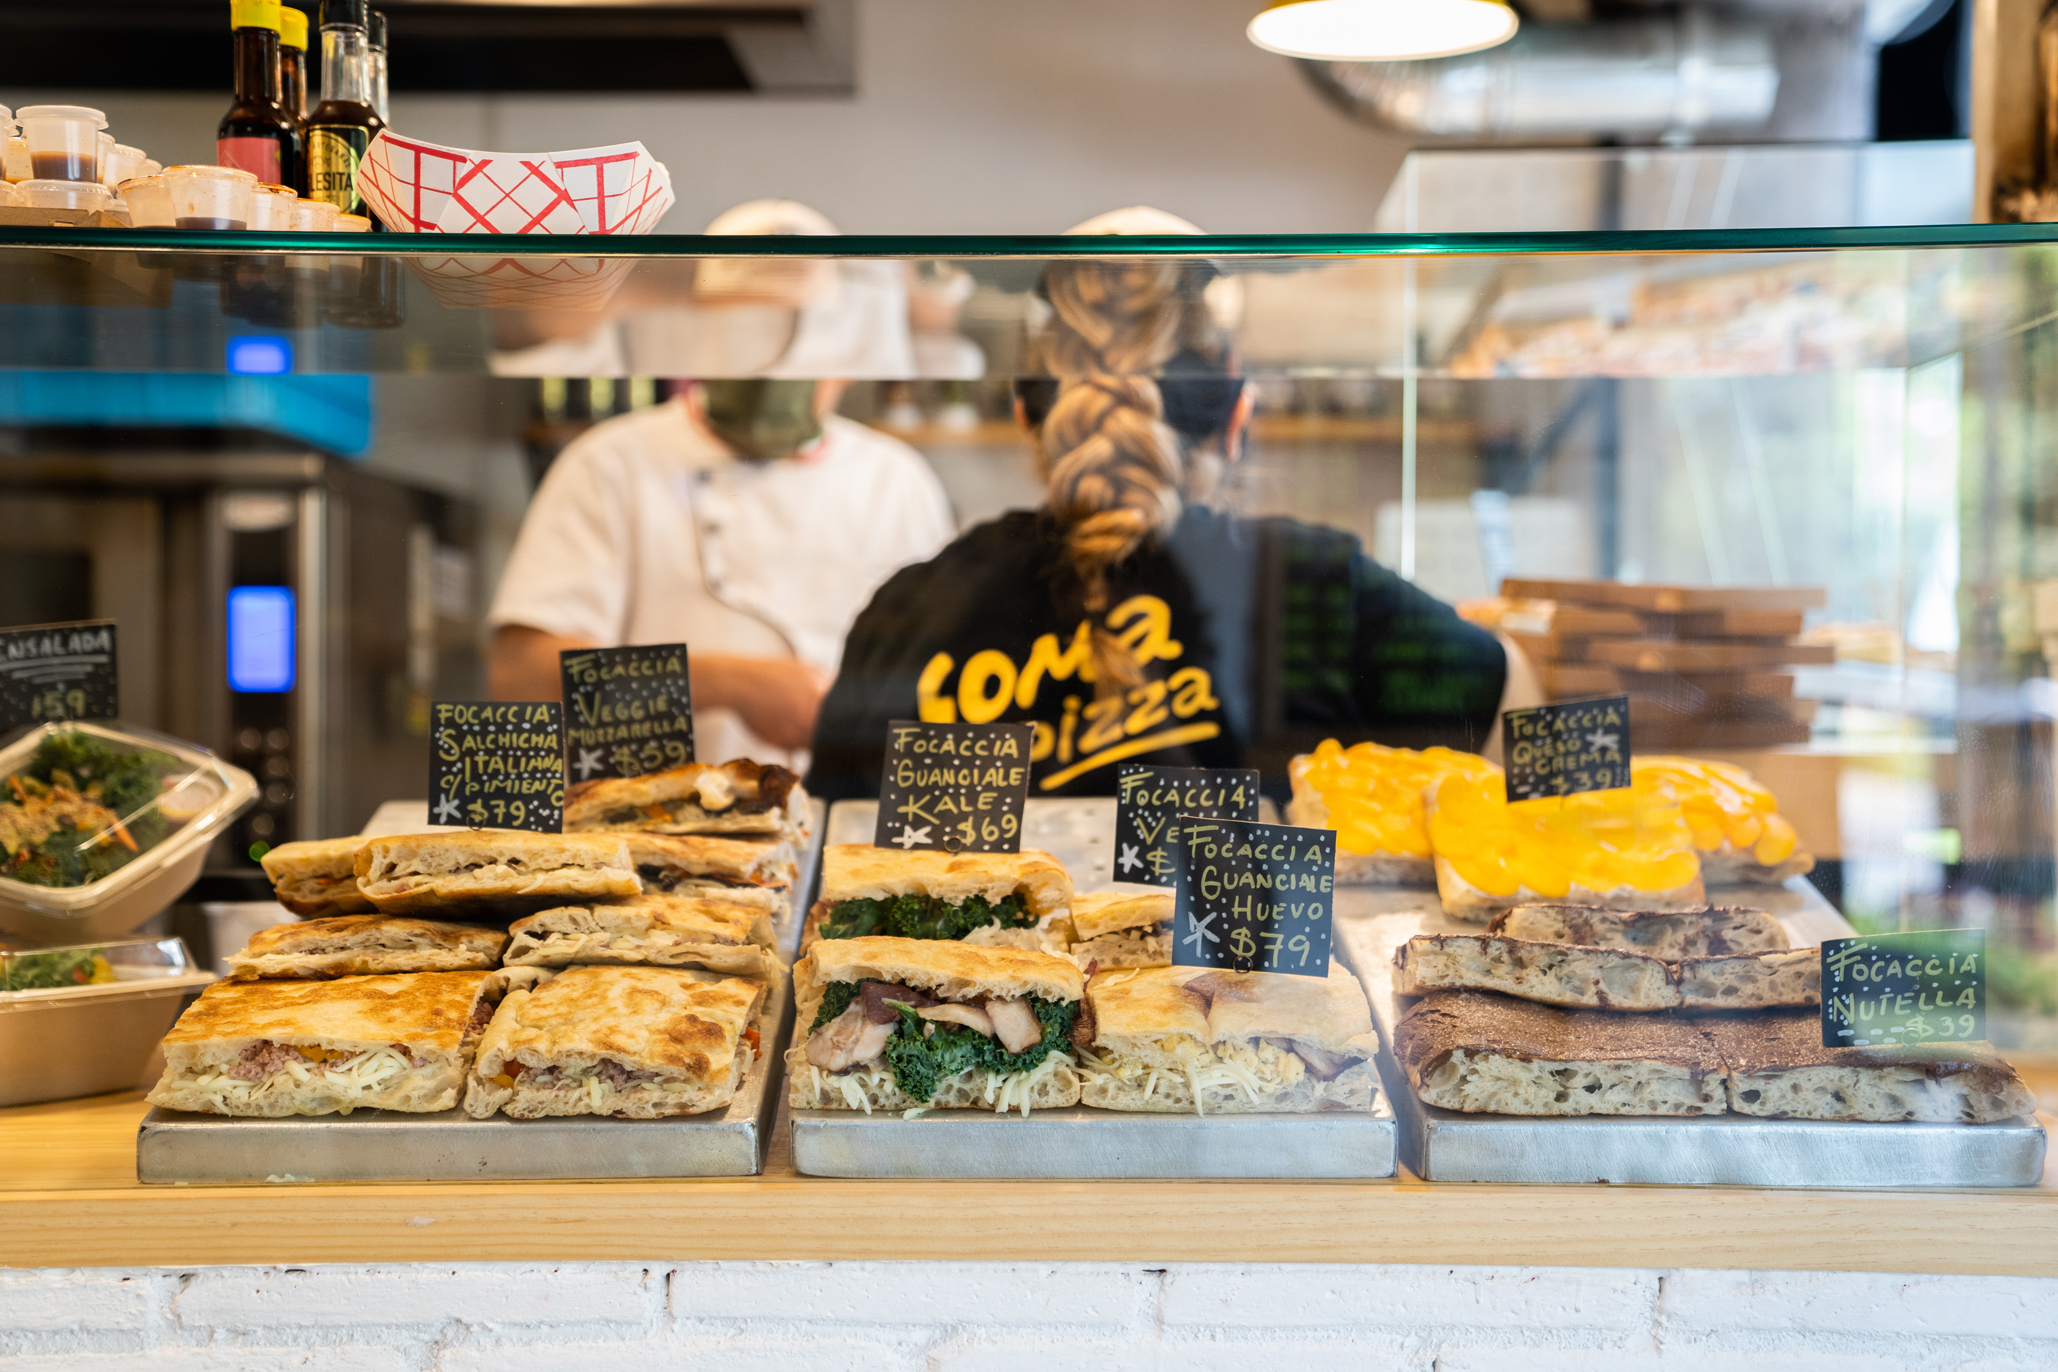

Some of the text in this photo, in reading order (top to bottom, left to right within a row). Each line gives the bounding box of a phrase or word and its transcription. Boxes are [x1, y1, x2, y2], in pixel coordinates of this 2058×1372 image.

[564, 653, 682, 684] FOCACCIA
[436, 704, 550, 724] FOCACCIA
[577, 690, 670, 727] VEGGIE
[1506, 708, 1622, 740] FOCACCIA
[438, 729, 558, 762] SALCHICHA
[892, 728, 1019, 758] FOCACCIA
[465, 753, 563, 783] ITALIANA
[614, 741, 688, 778] $59
[897, 759, 1025, 788] GUANCIALE
[1119, 772, 1246, 809] FOCACCIA
[467, 799, 525, 826] $79
[897, 792, 998, 825] KALE
[956, 814, 1018, 846] $69
[1182, 825, 1322, 864] FOCACCIA
[1201, 866, 1333, 900] GUANCIALE
[1231, 895, 1324, 921] HUEVO
[1229, 927, 1311, 968] $79
[1826, 942, 1977, 982] FOCACCIA
[1833, 988, 1977, 1024] NUTELLA
[1905, 1014, 1975, 1038] $39
